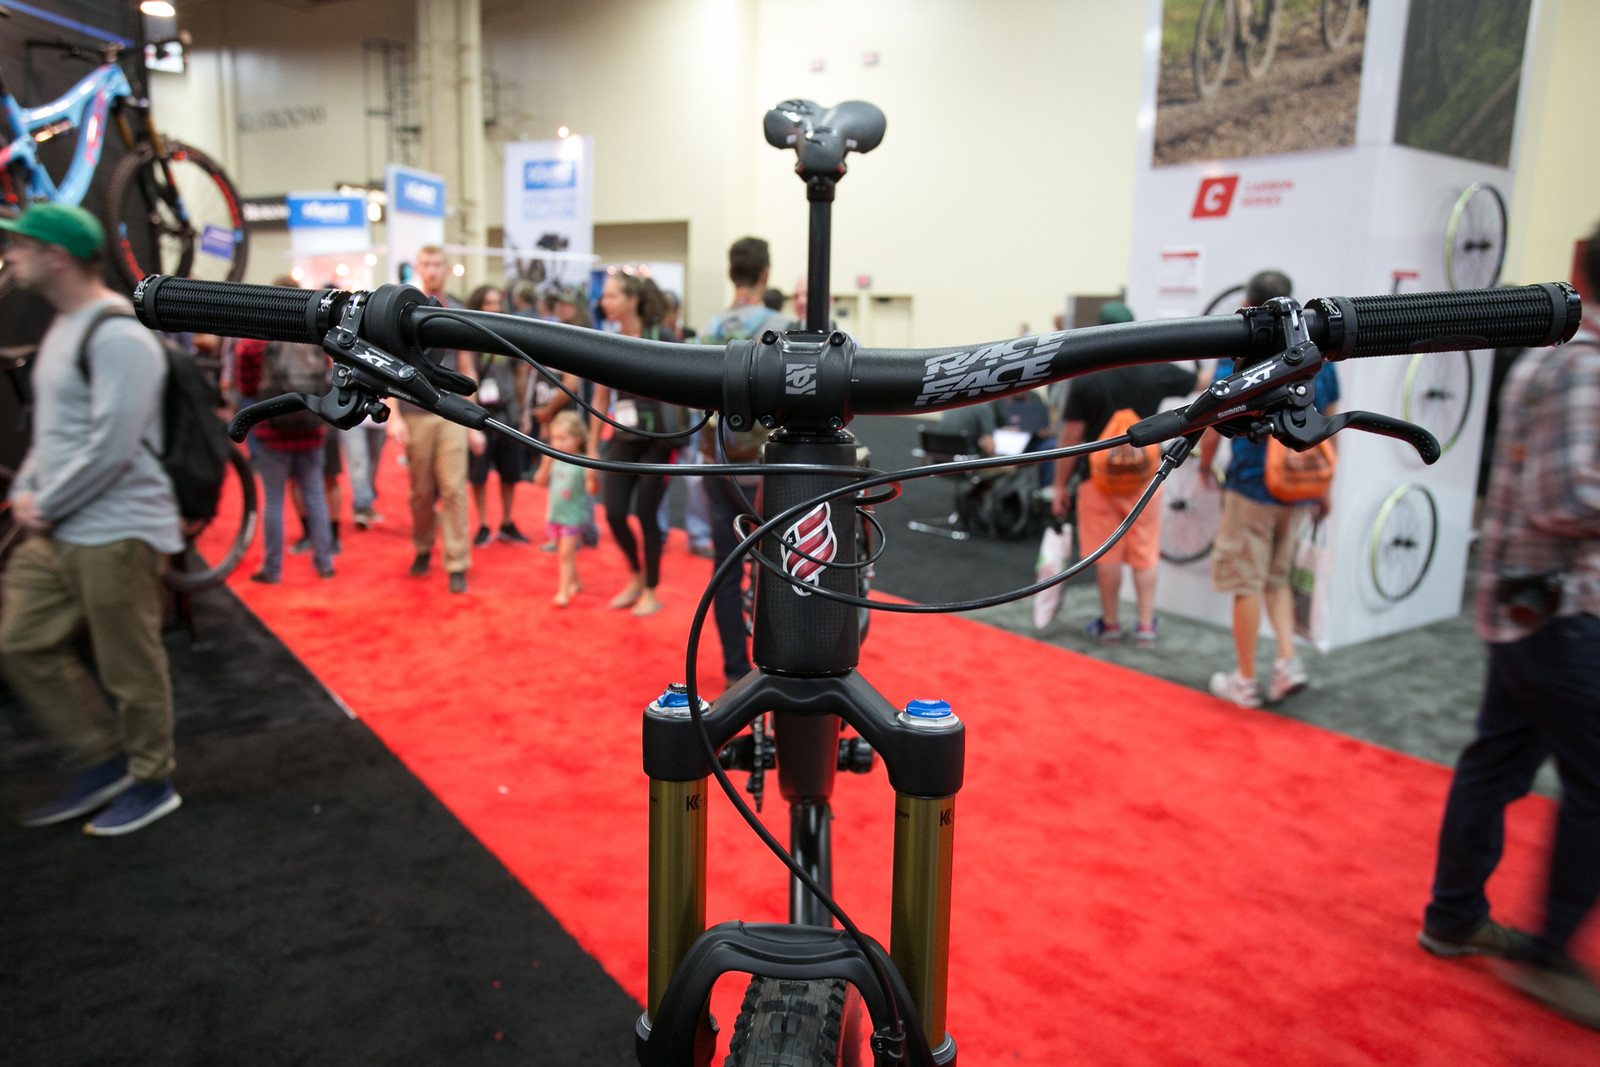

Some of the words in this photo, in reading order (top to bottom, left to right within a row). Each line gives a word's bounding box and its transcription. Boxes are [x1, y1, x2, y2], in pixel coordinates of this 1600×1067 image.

[356, 350, 392, 368] XT
[922, 332, 1067, 382] RACE
[1242, 360, 1274, 376] DEORE
[914, 351, 1059, 407] FACE
[1240, 364, 1277, 391] XT
[1217, 404, 1247, 419] SHIMANO
